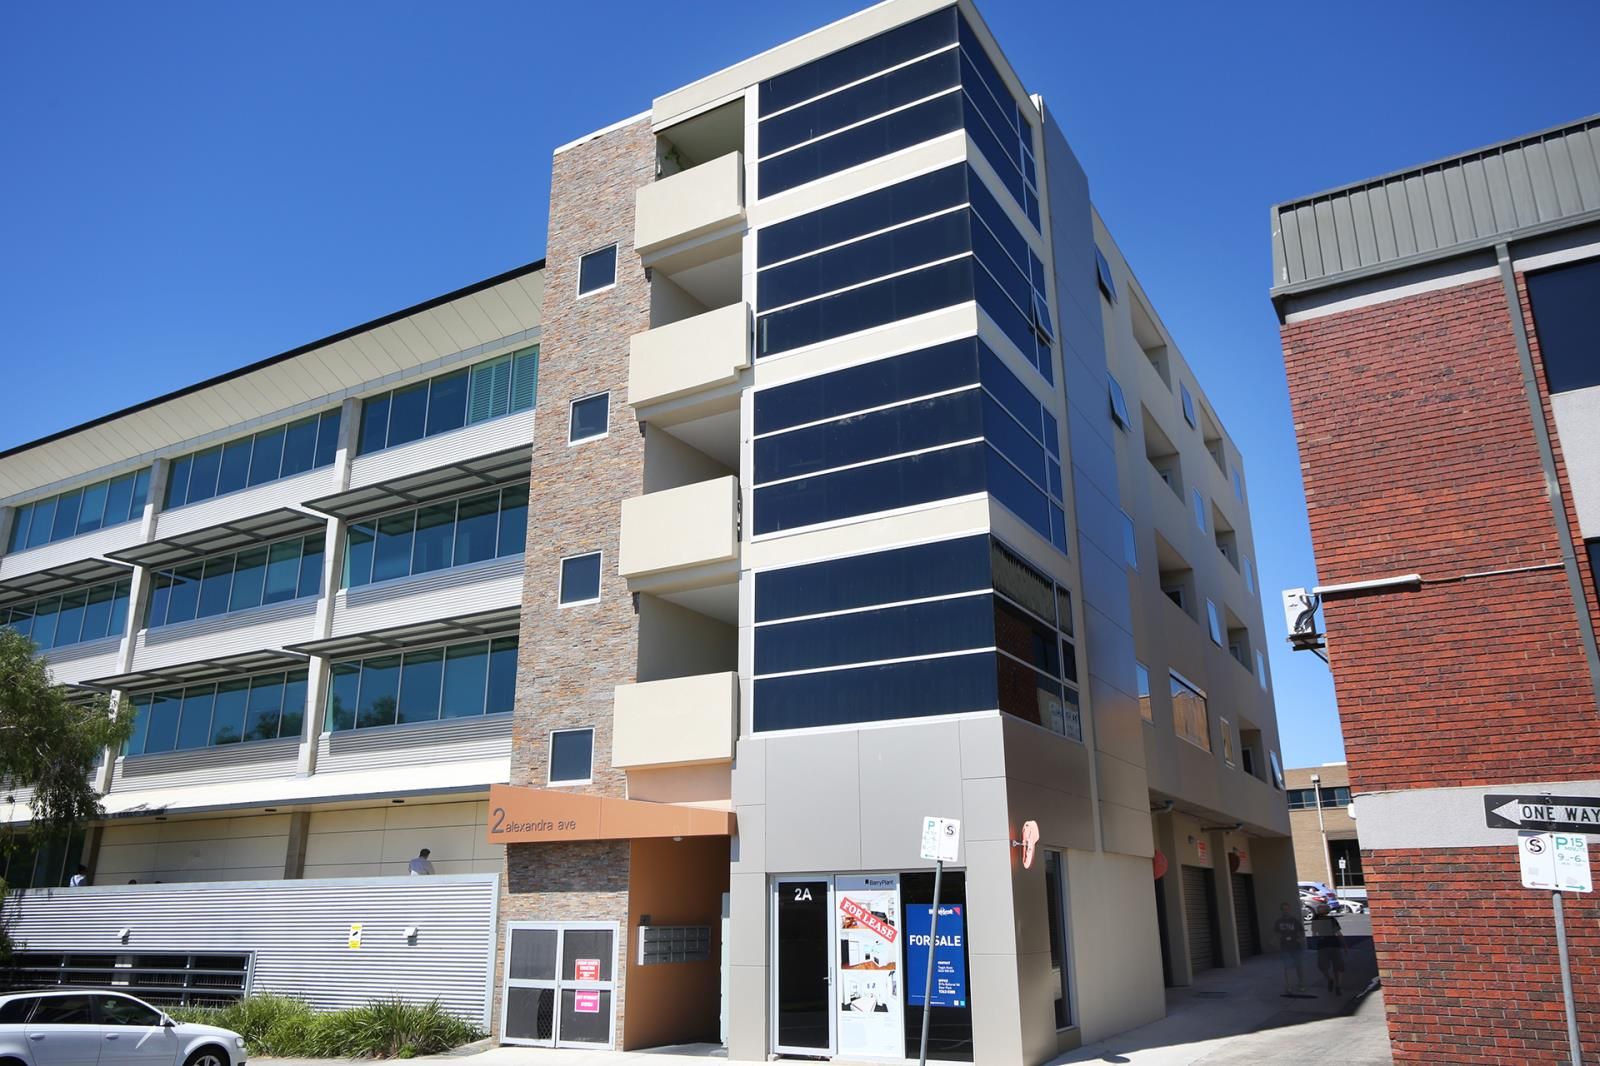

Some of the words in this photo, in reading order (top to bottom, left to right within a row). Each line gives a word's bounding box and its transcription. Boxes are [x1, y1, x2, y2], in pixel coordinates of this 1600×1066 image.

[491, 807, 506, 834] 2
[505, 820, 554, 833] alexandra
[557, 820, 577, 831] ave
[1522, 805, 1556, 820] ONE
[1565, 807, 1600, 823] WAY
[927, 820, 936, 831] P
[946, 825, 954, 836] S
[1529, 838, 1542, 853] S
[794, 887, 813, 901] 2A
[843, 900, 864, 919] FOR
[862, 913, 895, 939] LEASE
[909, 934, 931, 946] FOR
[934, 935, 962, 947] SALE
